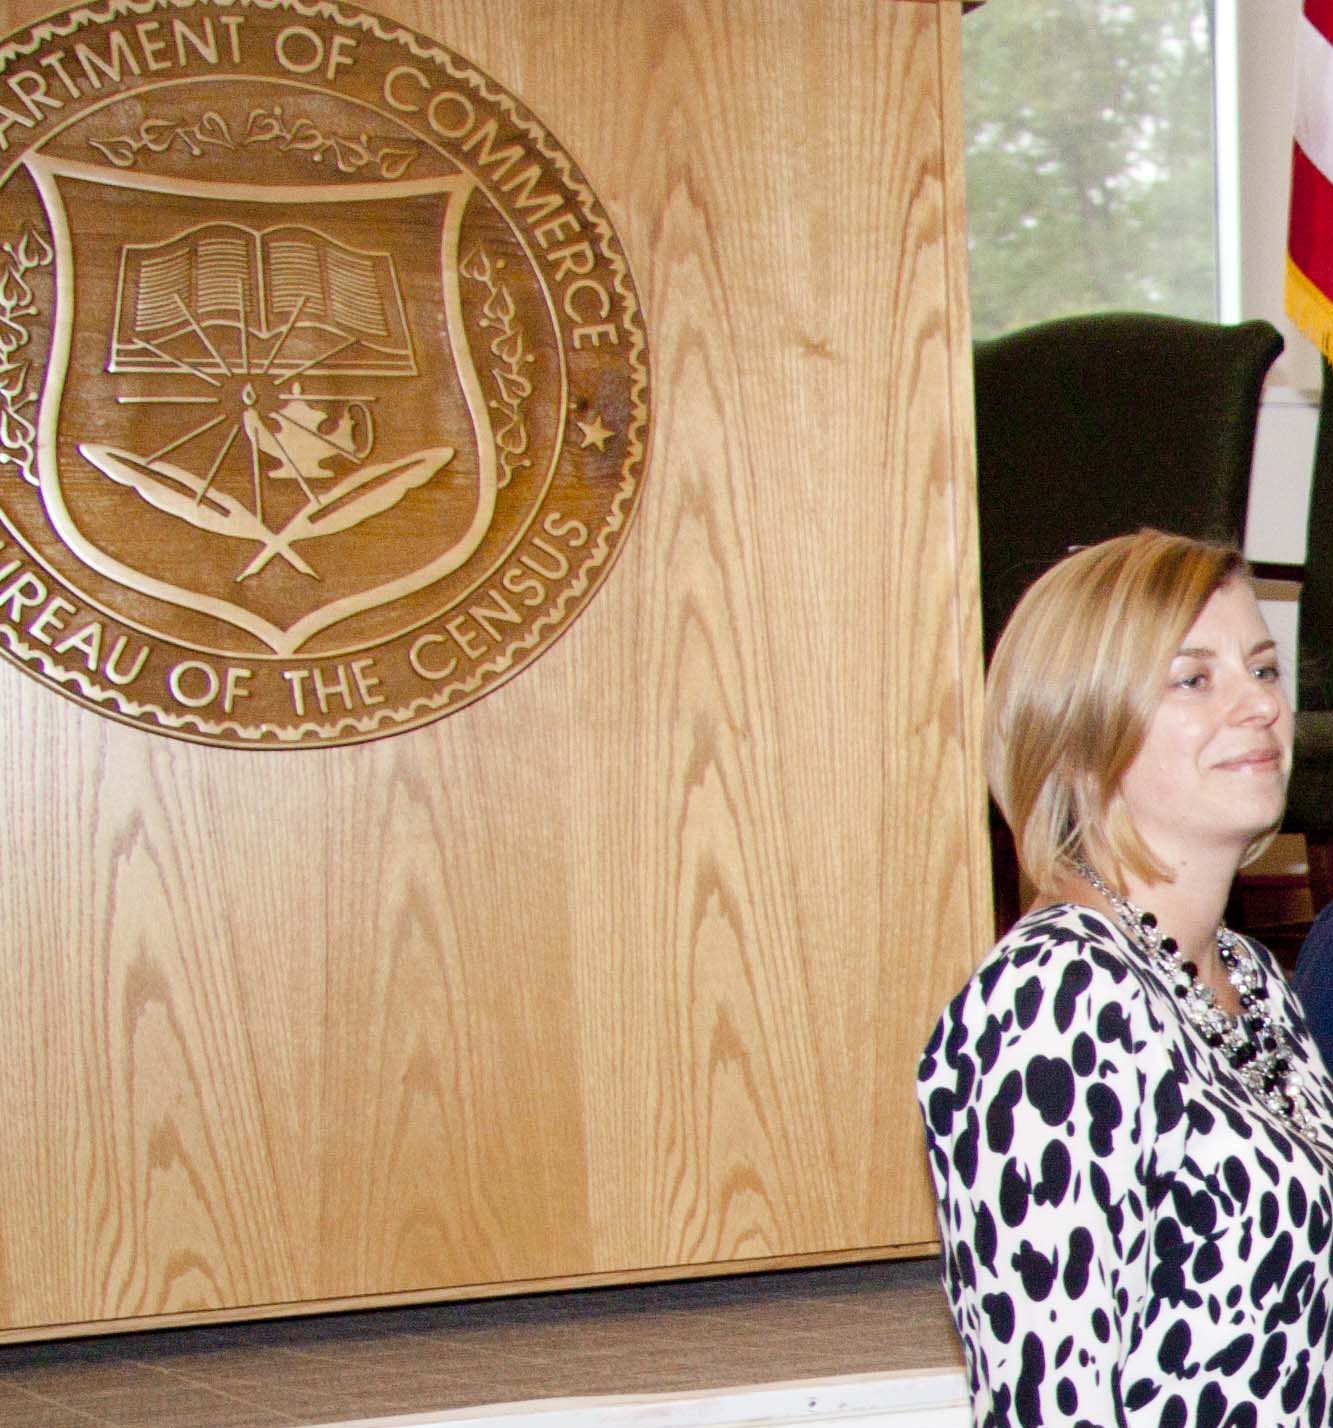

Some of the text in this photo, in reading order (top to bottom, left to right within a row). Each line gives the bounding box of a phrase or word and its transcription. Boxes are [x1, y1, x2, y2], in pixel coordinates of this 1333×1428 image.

[275, 25, 358, 79] OF
[383, 66, 620, 352] COMMERCE
[168, 660, 252, 713] OF
[282, 658, 384, 716] THE
[408, 511, 589, 681] CENSUS
